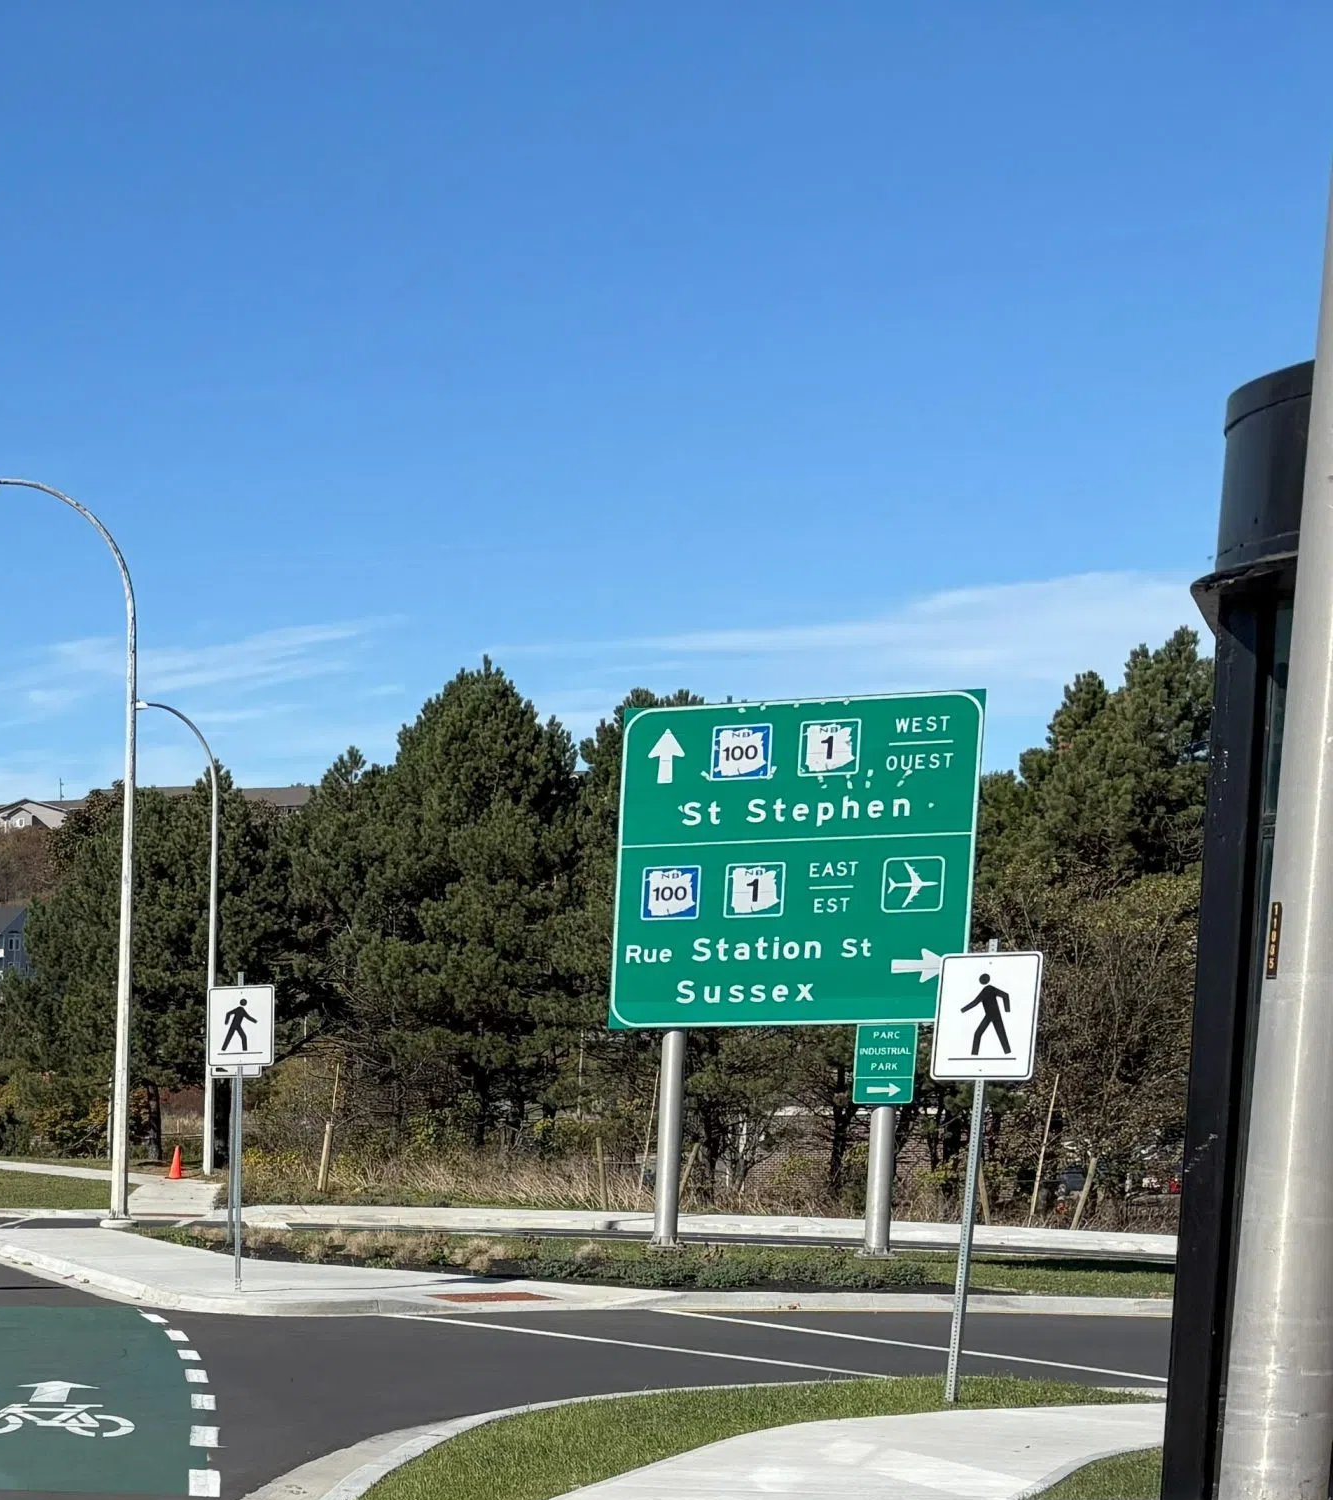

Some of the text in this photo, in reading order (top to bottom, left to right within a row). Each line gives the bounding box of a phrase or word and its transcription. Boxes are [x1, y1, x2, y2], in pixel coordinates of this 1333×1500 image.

[819, 726, 839, 734] NB
[895, 715, 951, 734] WEST
[731, 731, 751, 739] NB
[722, 744, 759, 762] 100
[820, 735, 835, 760] 1
[885, 752, 955, 772] OUEST
[681, 795, 912, 828] St Stephen
[661, 872, 680, 880] NB
[744, 868, 764, 876] NB
[808, 861, 859, 878] EAST
[652, 886, 687, 902] 100
[746, 878, 760, 903] 1
[813, 897, 851, 914] EST
[624, 936, 873, 964] Rue Station St
[675, 979, 815, 1005] Sussex
[873, 1031, 901, 1039] PARC
[859, 1047, 912, 1056] INDUSTRIAL
[870, 1062, 898, 1071] PARK
